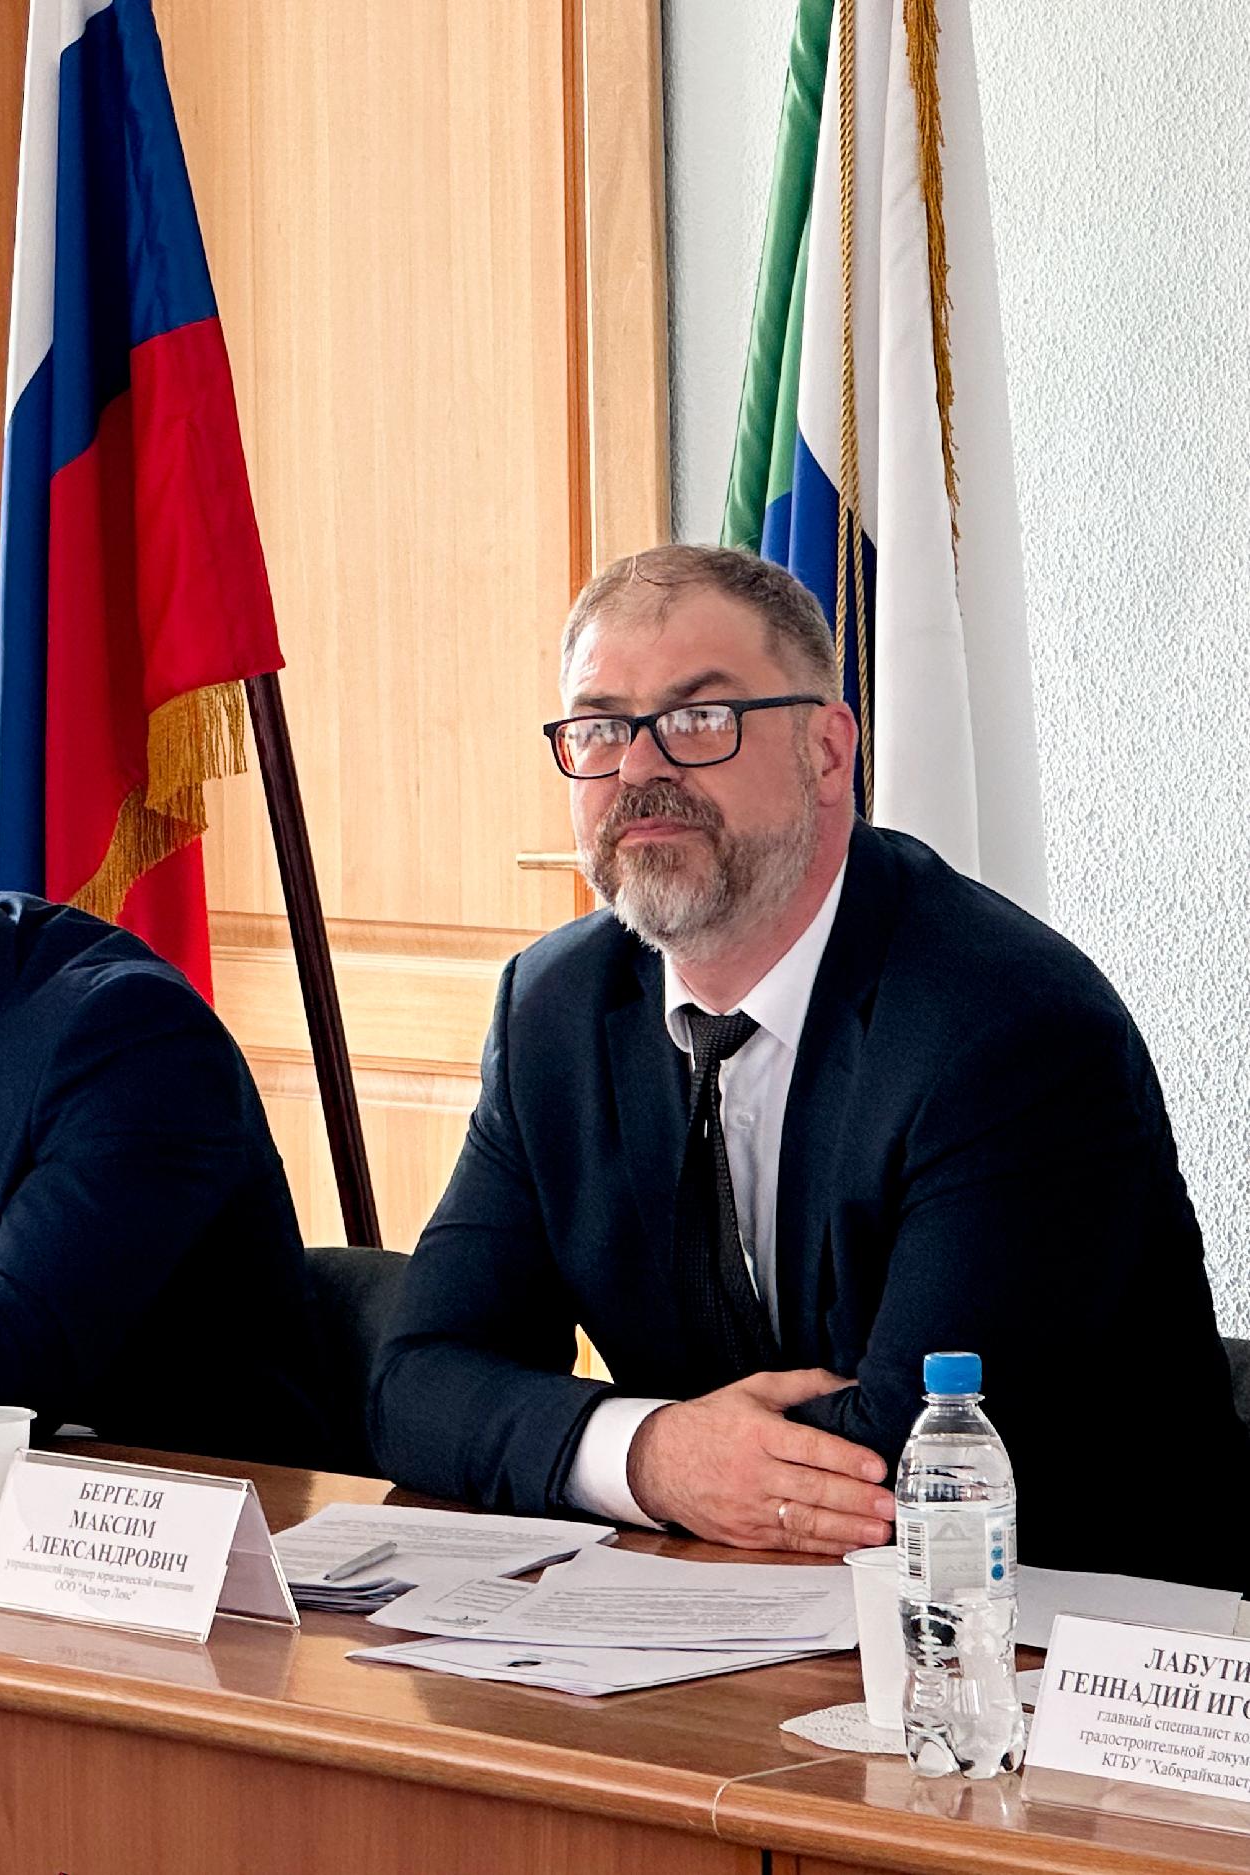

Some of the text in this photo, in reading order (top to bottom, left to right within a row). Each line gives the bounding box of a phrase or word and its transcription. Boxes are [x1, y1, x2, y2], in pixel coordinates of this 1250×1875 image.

[78, 1481, 165, 1510] БЕРГЕЛЯ
[69, 1509, 157, 1539] МАКСИМ
[23, 1535, 189, 1573] АЛЕКСАНДРОВИЧ
[54, 1579, 76, 1592] ООО
[1144, 1648, 1250, 1683] ЛАБУТИ
[1058, 1669, 1202, 1711] ГЕННАДИЙ
[1079, 1729, 1205, 1760] градостроительной
[1096, 1710, 1250, 1745] главный специалист ко
[1102, 1751, 1250, 1793] КГБУ "Хабкрайкадаст
